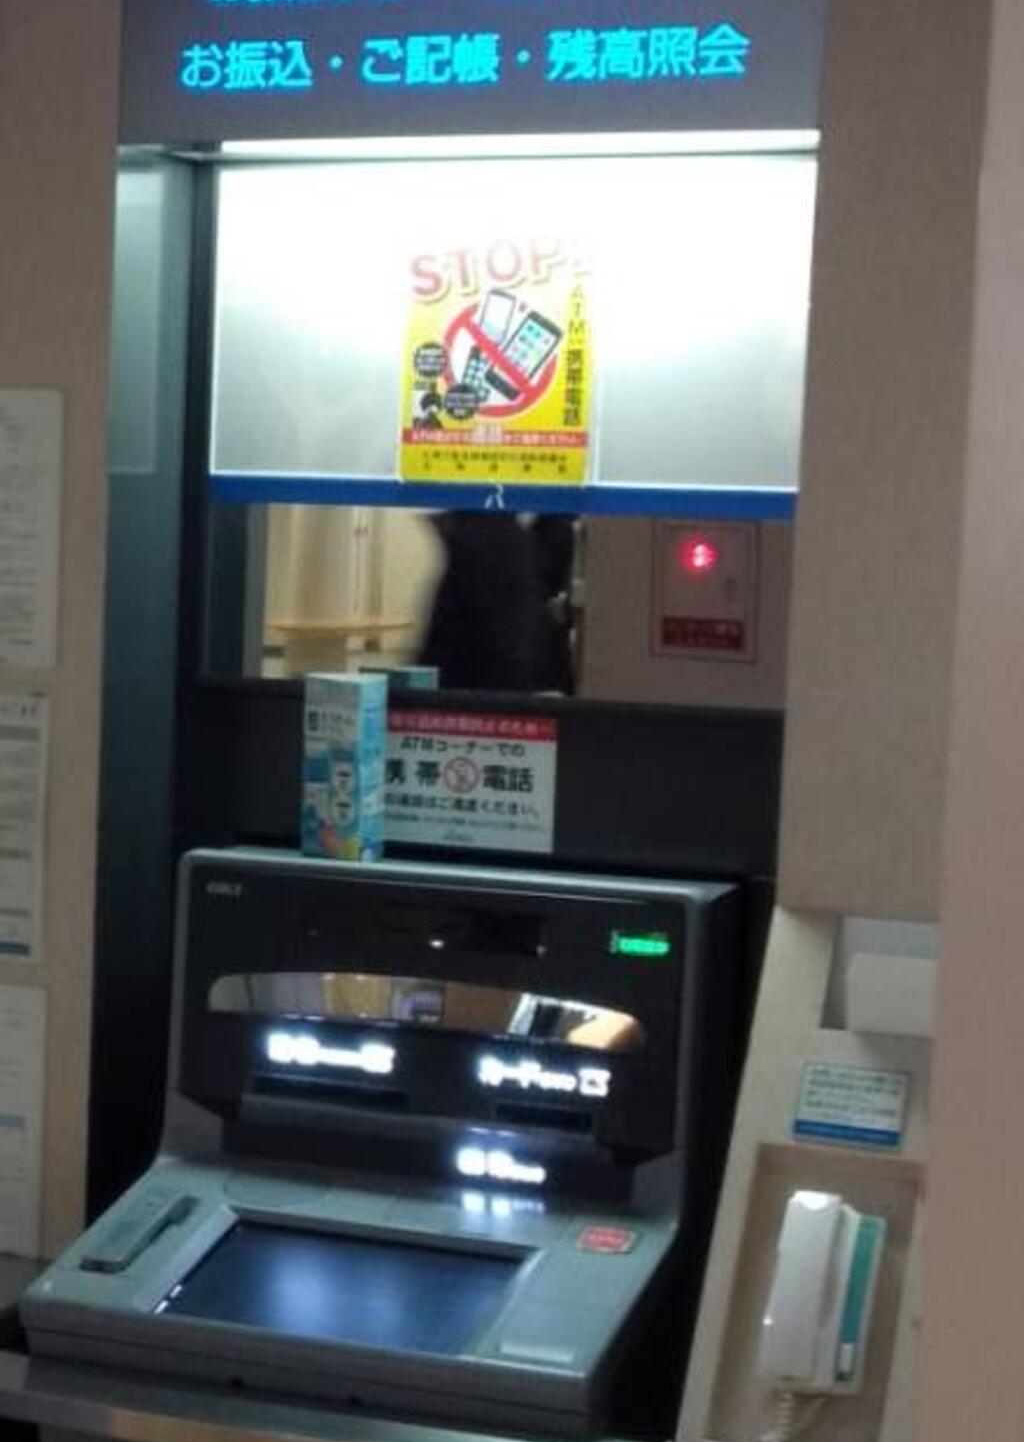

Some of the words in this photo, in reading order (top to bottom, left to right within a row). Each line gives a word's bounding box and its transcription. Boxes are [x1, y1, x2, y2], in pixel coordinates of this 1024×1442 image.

[180, 21, 752, 90] お振込・ご記帳・残高照会
[409, 234, 594, 306] STOP
[400, 736, 525, 758] ATMコーナーでの
